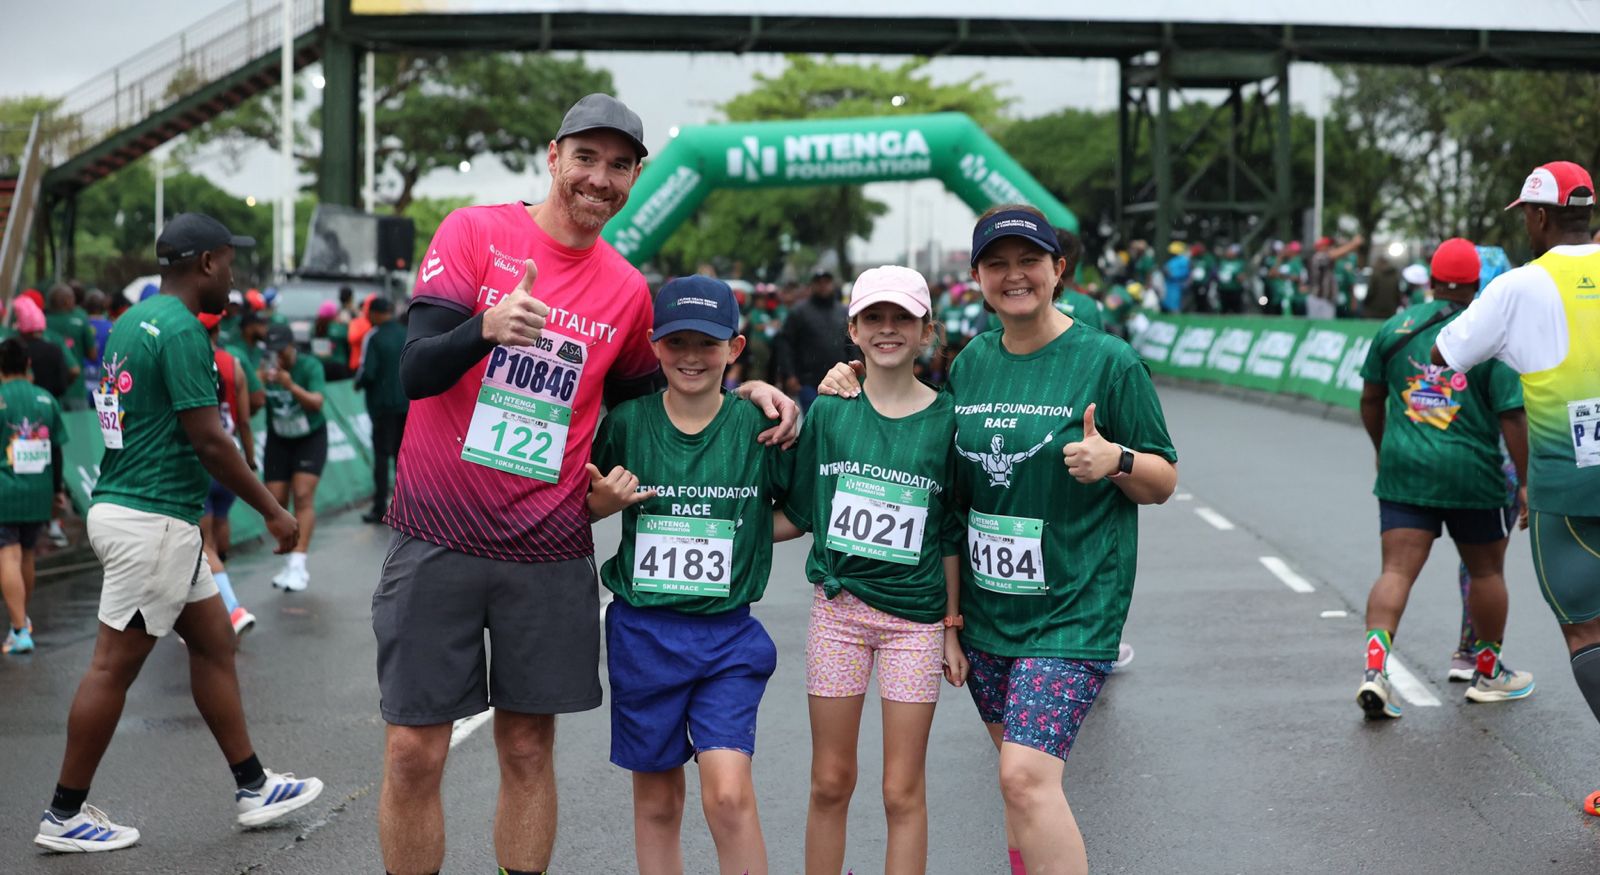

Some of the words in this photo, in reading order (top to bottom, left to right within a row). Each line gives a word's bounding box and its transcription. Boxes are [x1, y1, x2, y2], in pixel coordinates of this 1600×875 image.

[784, 129, 930, 162] NTENGA
[785, 157, 931, 179] FOUNDATION
[494, 257, 519, 277] Vitality
[548, 306, 617, 343] ITALITY
[532, 336, 553, 352] 025
[562, 343, 581, 357] ASA
[486, 346, 577, 402] P10846
[504, 395, 537, 410] NTENGA
[994, 403, 1073, 418] FOUNDATION
[984, 417, 1018, 428] RACE
[491, 421, 553, 464] 122
[494, 459, 514, 470] 10KM
[515, 463, 533, 474] RACE
[820, 460, 860, 476] NTENGA
[862, 463, 943, 495] FOUNDATION
[856, 481, 885, 492] NTENGA
[671, 503, 711, 515] RACE
[658, 520, 690, 528] NTENGA
[834, 505, 915, 549] 4021
[852, 544, 867, 553] 5KM
[868, 547, 887, 557] RACE
[640, 545, 724, 582] 4183
[972, 541, 1036, 579] 4184
[662, 583, 679, 591] 5KM
[680, 584, 699, 592] RACE
